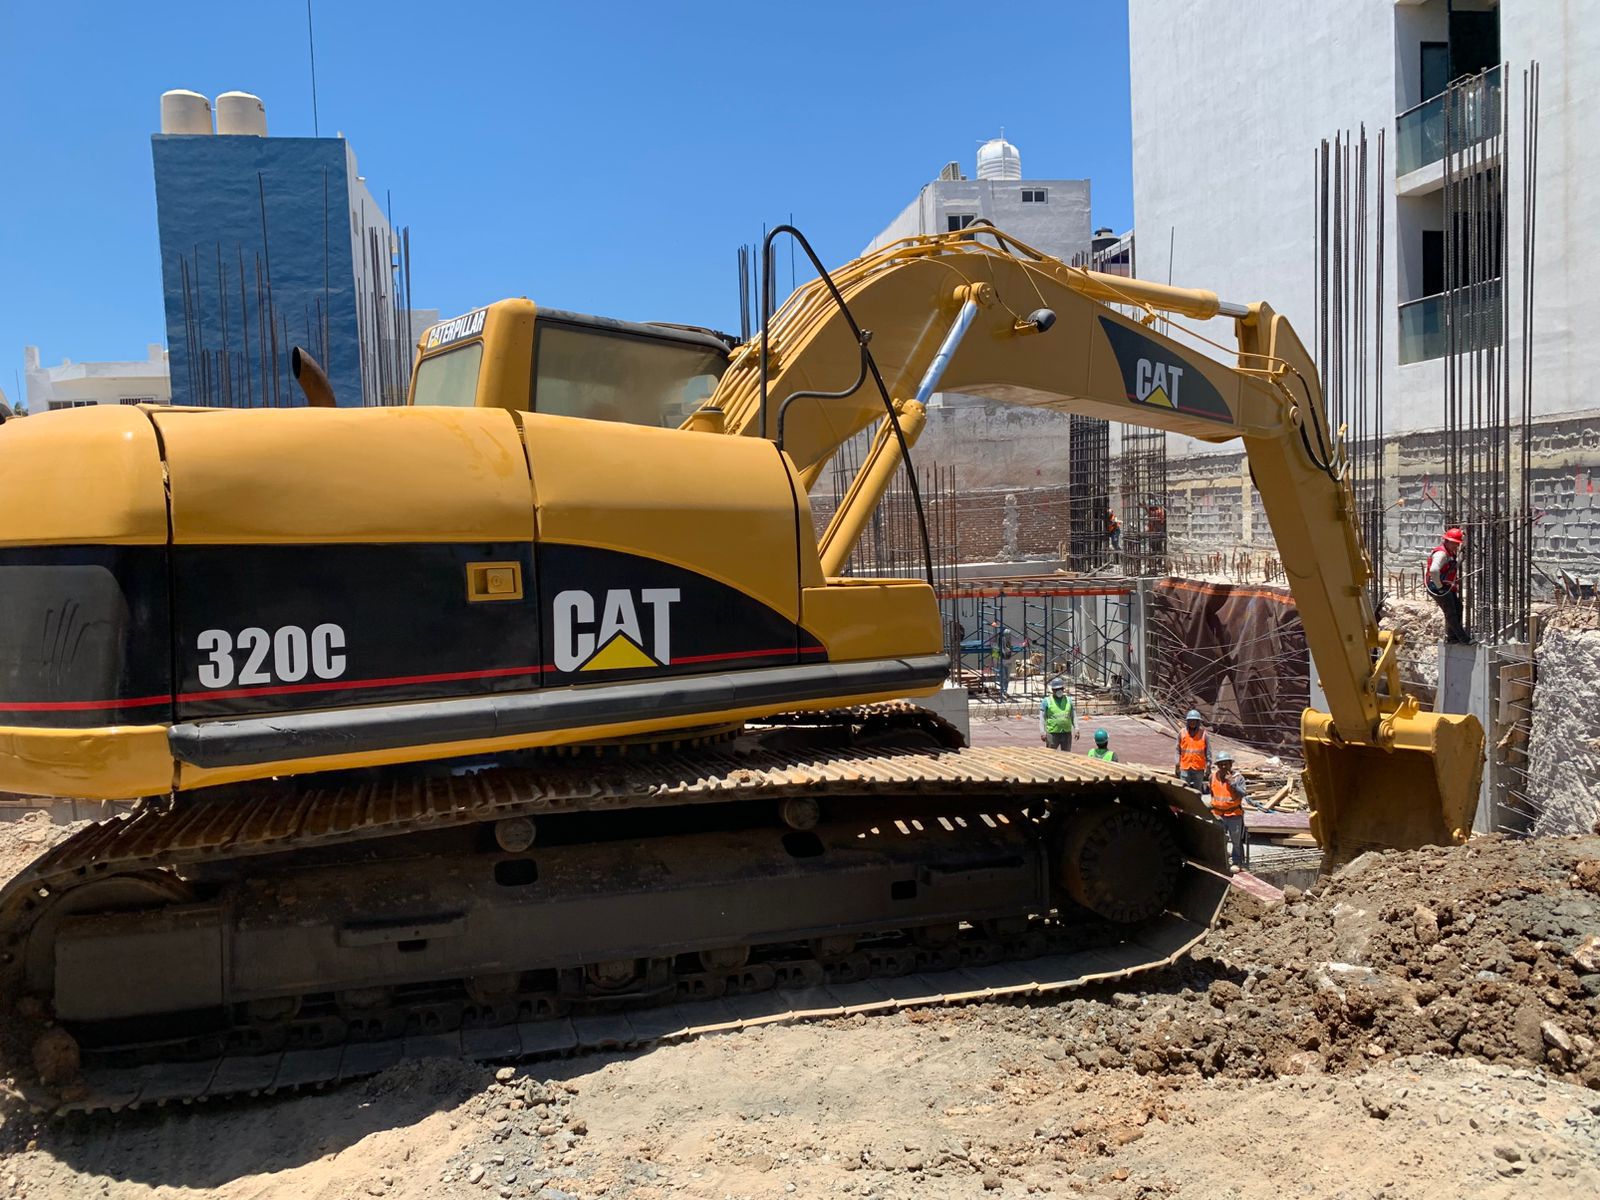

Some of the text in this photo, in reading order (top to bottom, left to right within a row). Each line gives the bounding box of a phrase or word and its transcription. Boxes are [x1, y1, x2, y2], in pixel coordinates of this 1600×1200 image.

[427, 310, 486, 349] CATERPILLAR
[1136, 358, 1183, 409] CAT
[197, 623, 347, 689] 320C
[553, 588, 681, 672] CAT
